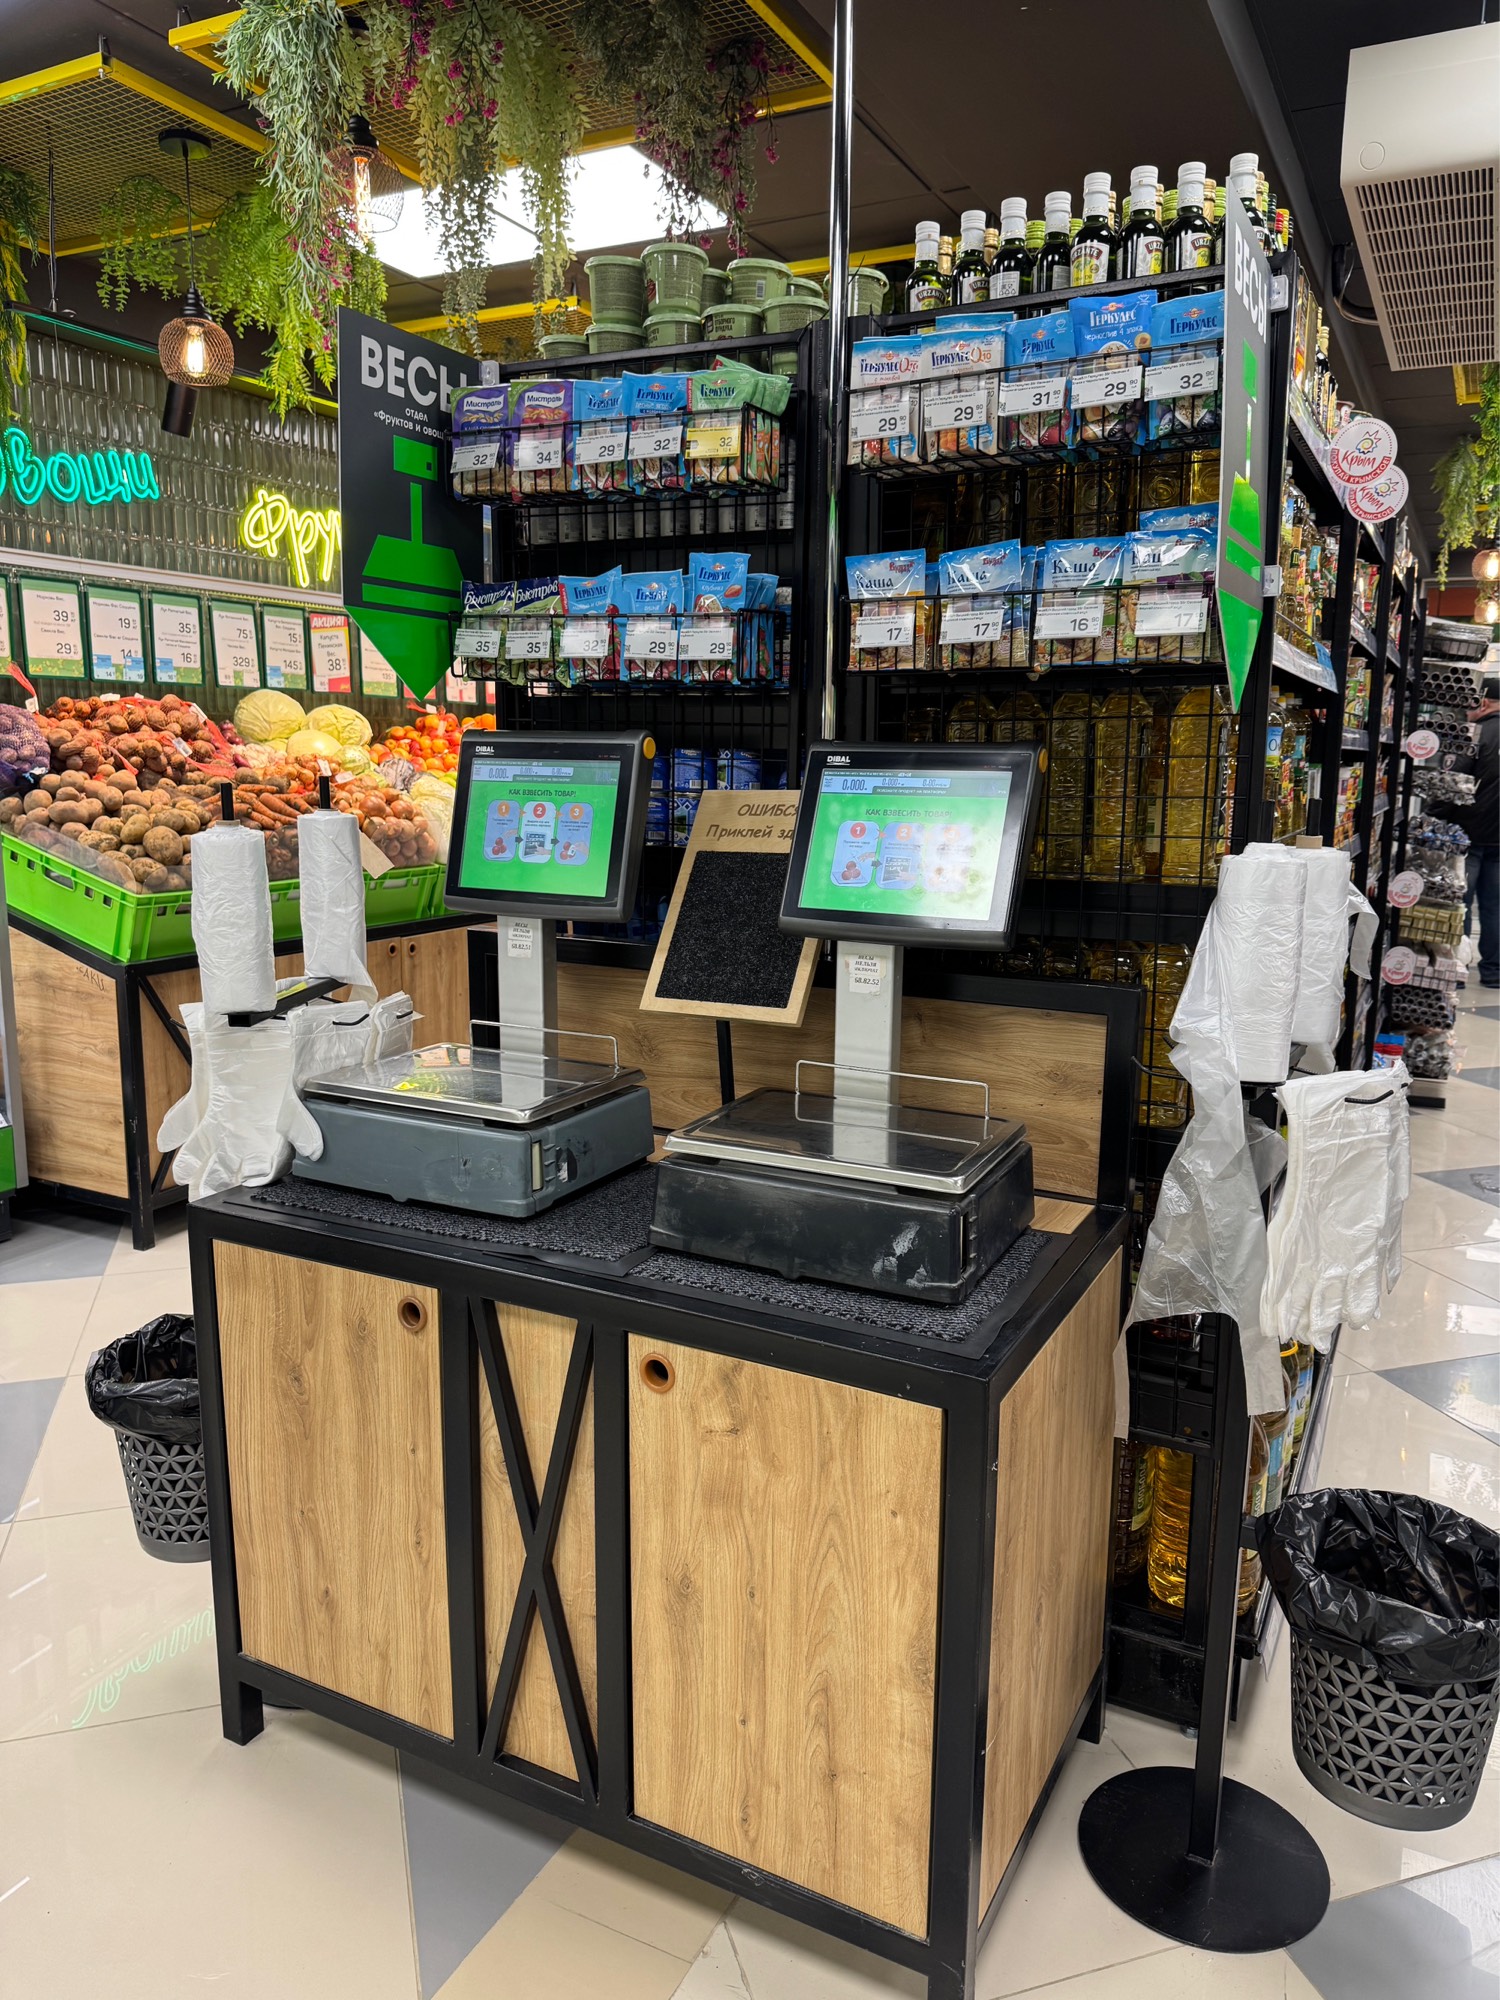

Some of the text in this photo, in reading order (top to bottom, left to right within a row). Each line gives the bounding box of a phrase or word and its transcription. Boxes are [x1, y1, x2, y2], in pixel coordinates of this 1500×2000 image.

[1234, 221, 1267, 344] ВЕСЫ
[1090, 310, 1136, 328] Геркулес
[1170, 315, 1218, 335] Геркулес
[931, 346, 992, 367] Геркулес Q10
[860, 358, 899, 373] Геркулес
[1180, 373, 1203, 390] 32
[1104, 381, 1127, 398] 29
[465, 400, 502, 410] Мистраль
[526, 395, 563, 405] Мистраль
[1032, 392, 1051, 407] 31
[373, 409, 422, 433] «Фруктов и
[405, 407, 428, 422] отдел
[954, 406, 974, 422] 29
[878, 416, 897, 432] 29
[653, 438, 671, 452] 32
[720, 436, 733, 447] 32
[536, 451, 553, 465] 34
[598, 444, 616, 458] 29
[0, 427, 160, 505] вощи
[472, 454, 488, 466] 32
[1330, 447, 1392, 484] ПОКУПАЙ КРЫМСКОЕ!
[1341, 449, 1377, 471] Крым
[1358, 484, 1385, 511] Крым
[242, 488, 341, 588] Фру
[698, 566, 732, 581] Геркулес
[856, 573, 894, 589] Каша
[515, 580, 558, 604] Быстров
[574, 584, 608, 600] Геркулес
[53, 609, 69, 622] 39
[311, 616, 345, 628] АКЦИЯ!
[1174, 612, 1194, 627] 17
[118, 617, 131, 629] 19
[178, 622, 191, 634] 35
[973, 623, 990, 637] 17
[1070, 618, 1089, 632] 16
[236, 628, 249, 640] 75
[288, 633, 298, 644] 15
[886, 627, 903, 641] 17
[56, 642, 72, 655] 29
[475, 640, 491, 653] 35
[526, 641, 541, 654] 35
[583, 640, 599, 652] 32
[649, 641, 667, 654] 29
[709, 643, 726, 655] 29
[120, 648, 133, 660] 14
[181, 652, 192, 663] 16
[232, 656, 251, 668] 329
[283, 659, 299, 671] 145
[327, 658, 342, 672] 38
[475, 745, 495, 753] DIBAL
[827, 755, 851, 764] DIBAL
[508, 788, 521, 796] КАК
[522, 789, 553, 797] ВЗВЕСИТЬ
[501, 805, 506, 813] 1
[537, 807, 543, 815] 2
[573, 808, 579, 816] 3
[865, 808, 881, 816] КАК
[883, 809, 922, 818] ВЗВЕСИТЬ
[706, 825, 795, 842] Приклей зд
[855, 825, 861, 836] 1
[900, 828, 907, 837] 2
